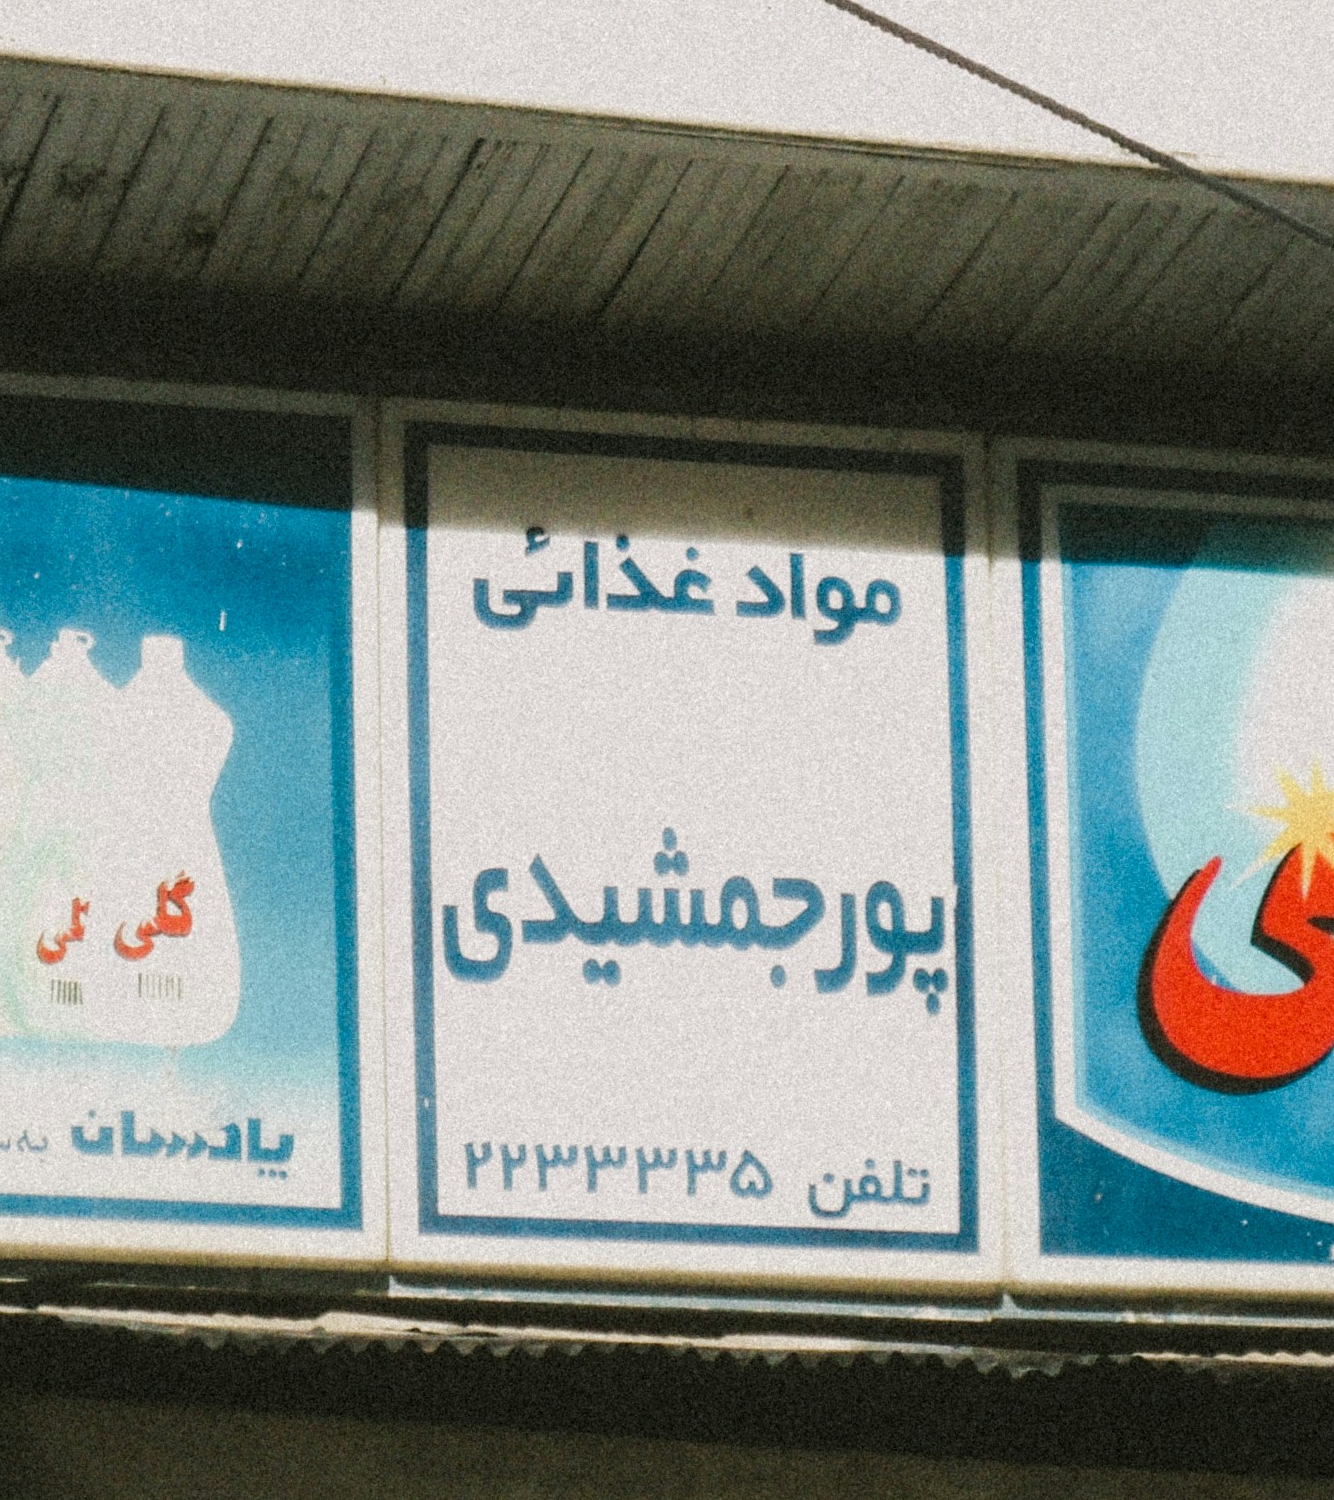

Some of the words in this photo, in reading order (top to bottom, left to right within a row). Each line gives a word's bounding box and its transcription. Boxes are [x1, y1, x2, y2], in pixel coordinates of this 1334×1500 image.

[473, 526, 715, 631] غذائی
[736, 552, 902, 645] مواد
[17, 1128, 50, 1163] به
[463, 1141, 774, 1199] ۲۲۳۳۳۳۵
[808, 1157, 931, 1218] تلفن
